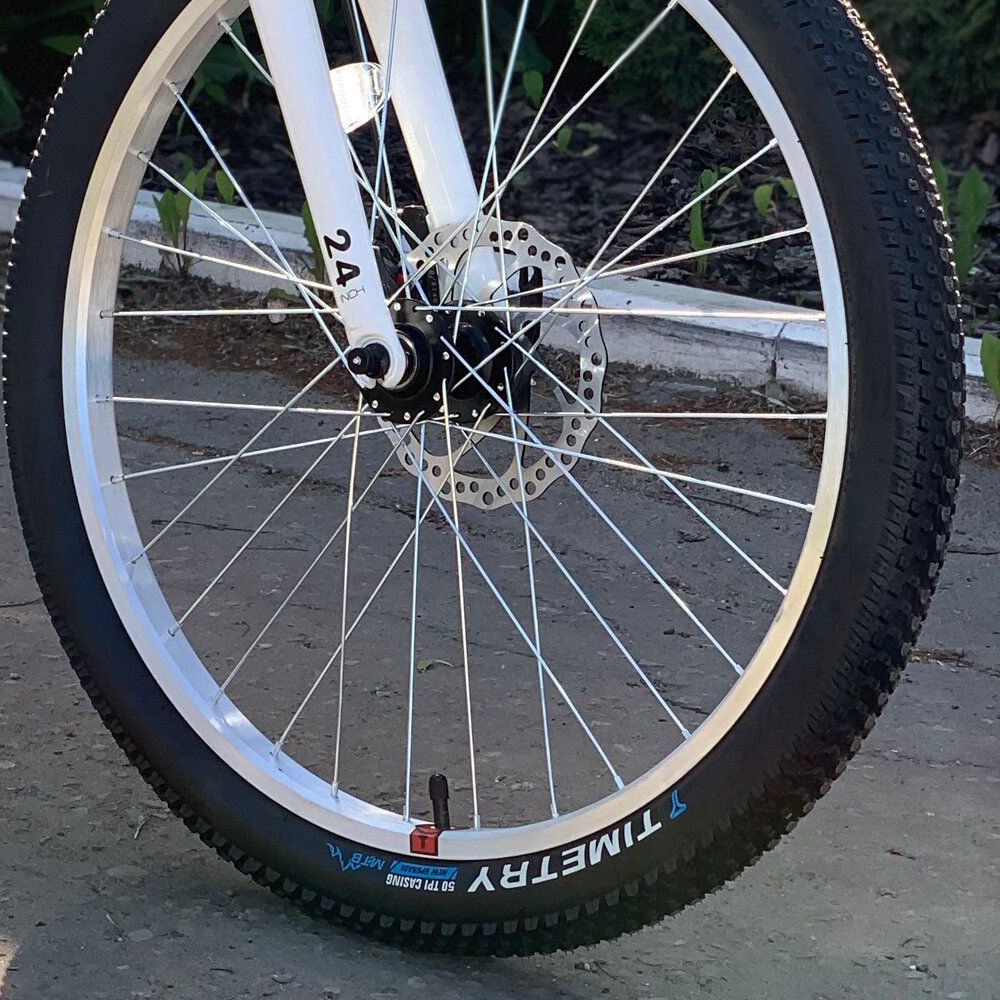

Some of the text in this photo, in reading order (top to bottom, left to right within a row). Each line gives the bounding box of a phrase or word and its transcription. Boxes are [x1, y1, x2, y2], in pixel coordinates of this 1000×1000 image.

[323, 228, 361, 288] 24
[467, 808, 663, 893] TIMETRY
[385, 873, 456, 892] 50 TPI CASING
[400, 864, 449, 877] NEW UPGRADE
